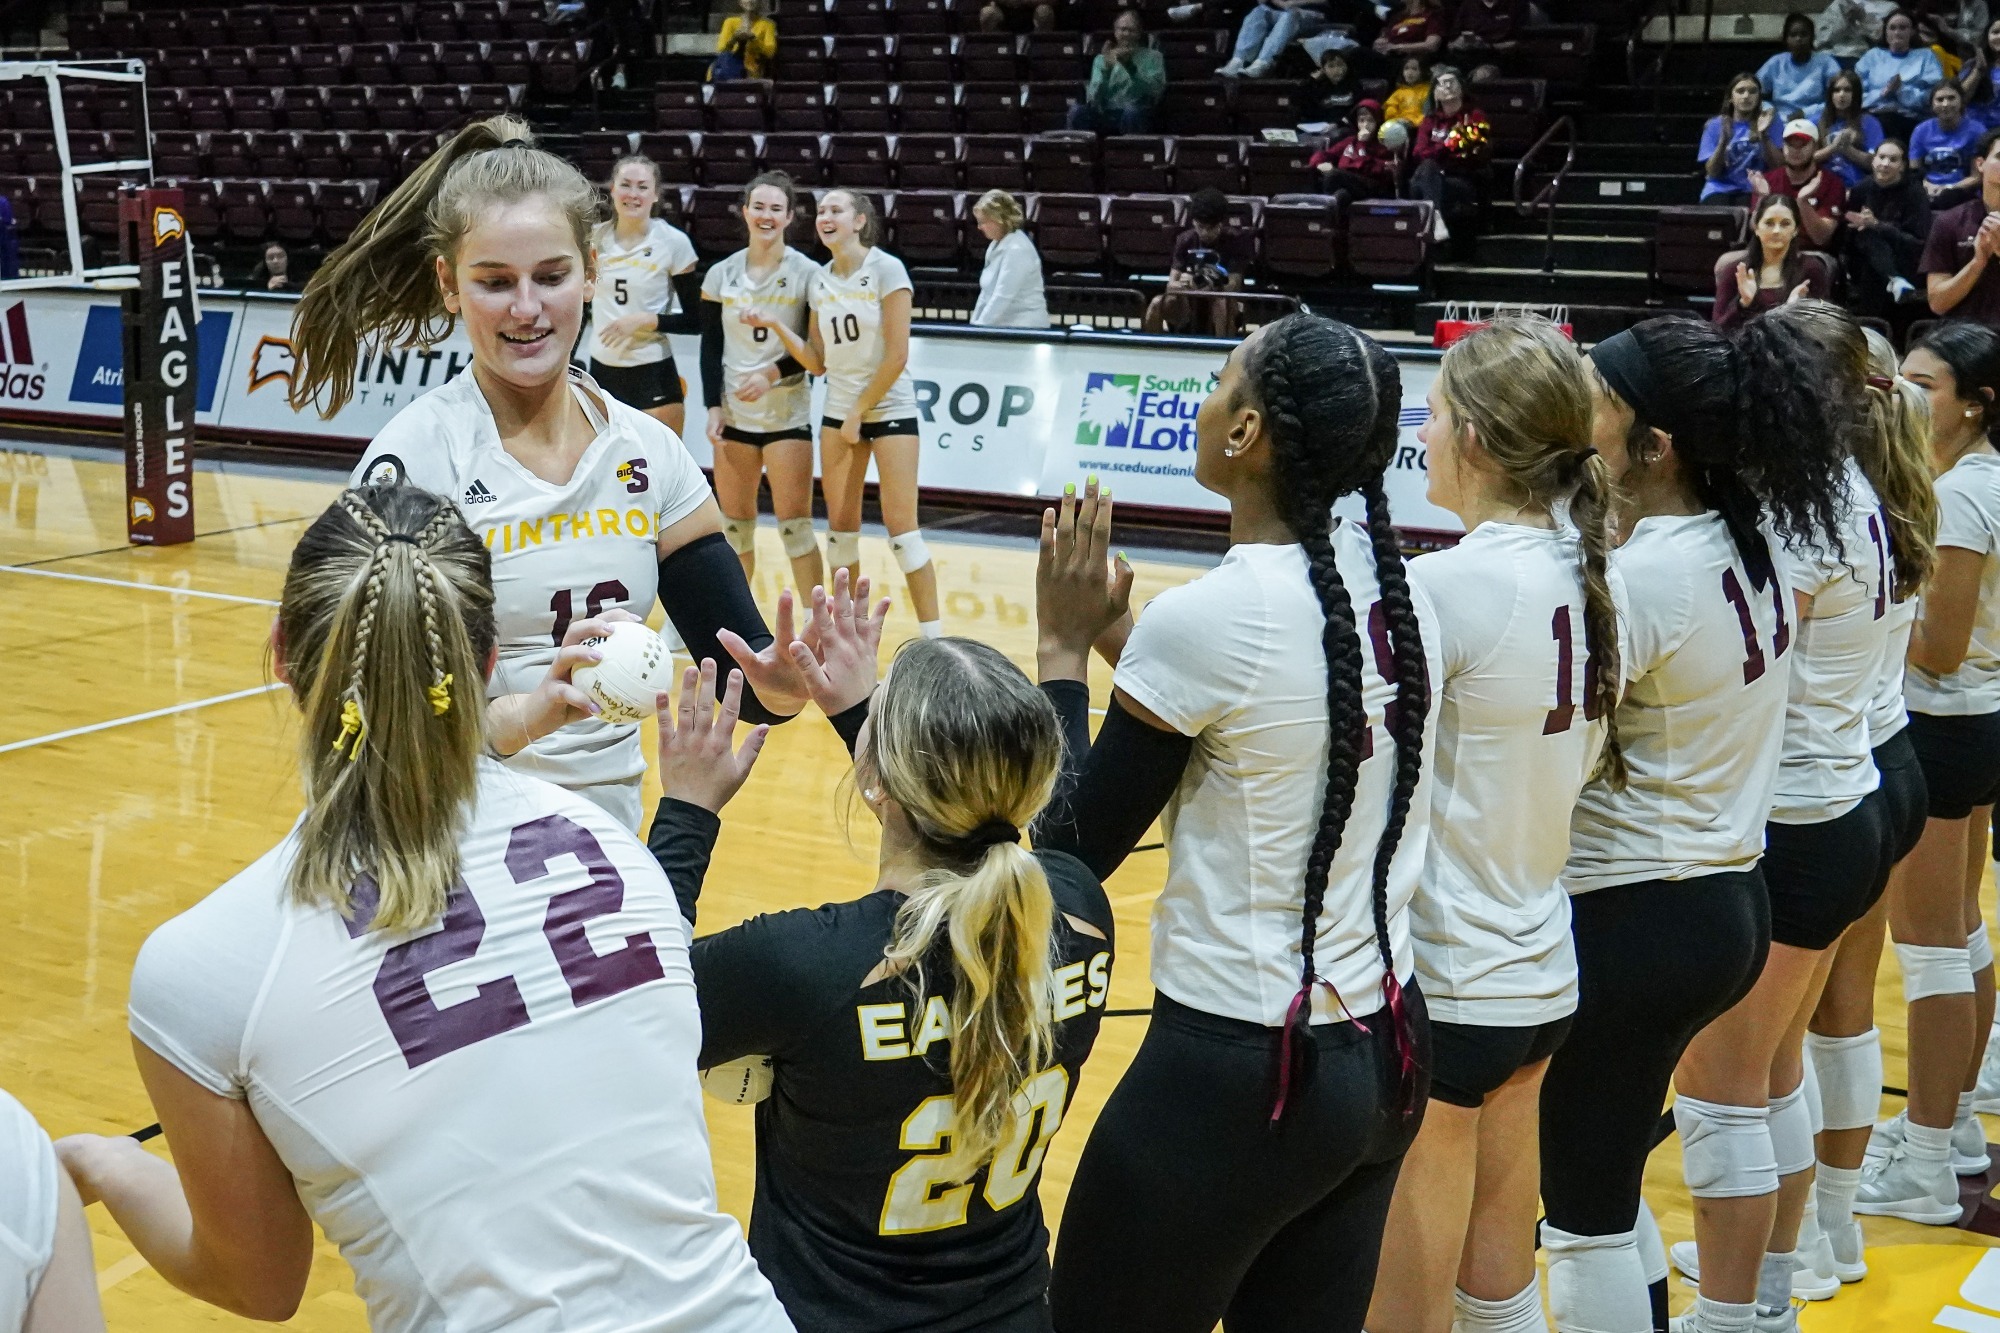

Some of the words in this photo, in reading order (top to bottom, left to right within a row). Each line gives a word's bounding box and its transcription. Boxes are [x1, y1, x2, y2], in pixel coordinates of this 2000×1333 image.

[615, 278, 628, 305] 5
[831, 313, 860, 344] 10
[358, 347, 474, 386] INTH
[1143, 374, 1201, 393] South
[159, 261, 189, 518] EAGLES
[1138, 392, 1200, 420] Edu
[341, 813, 666, 1070] 22
[856, 951, 1111, 1061] EAES
[878, 1063, 1070, 1236] 20
